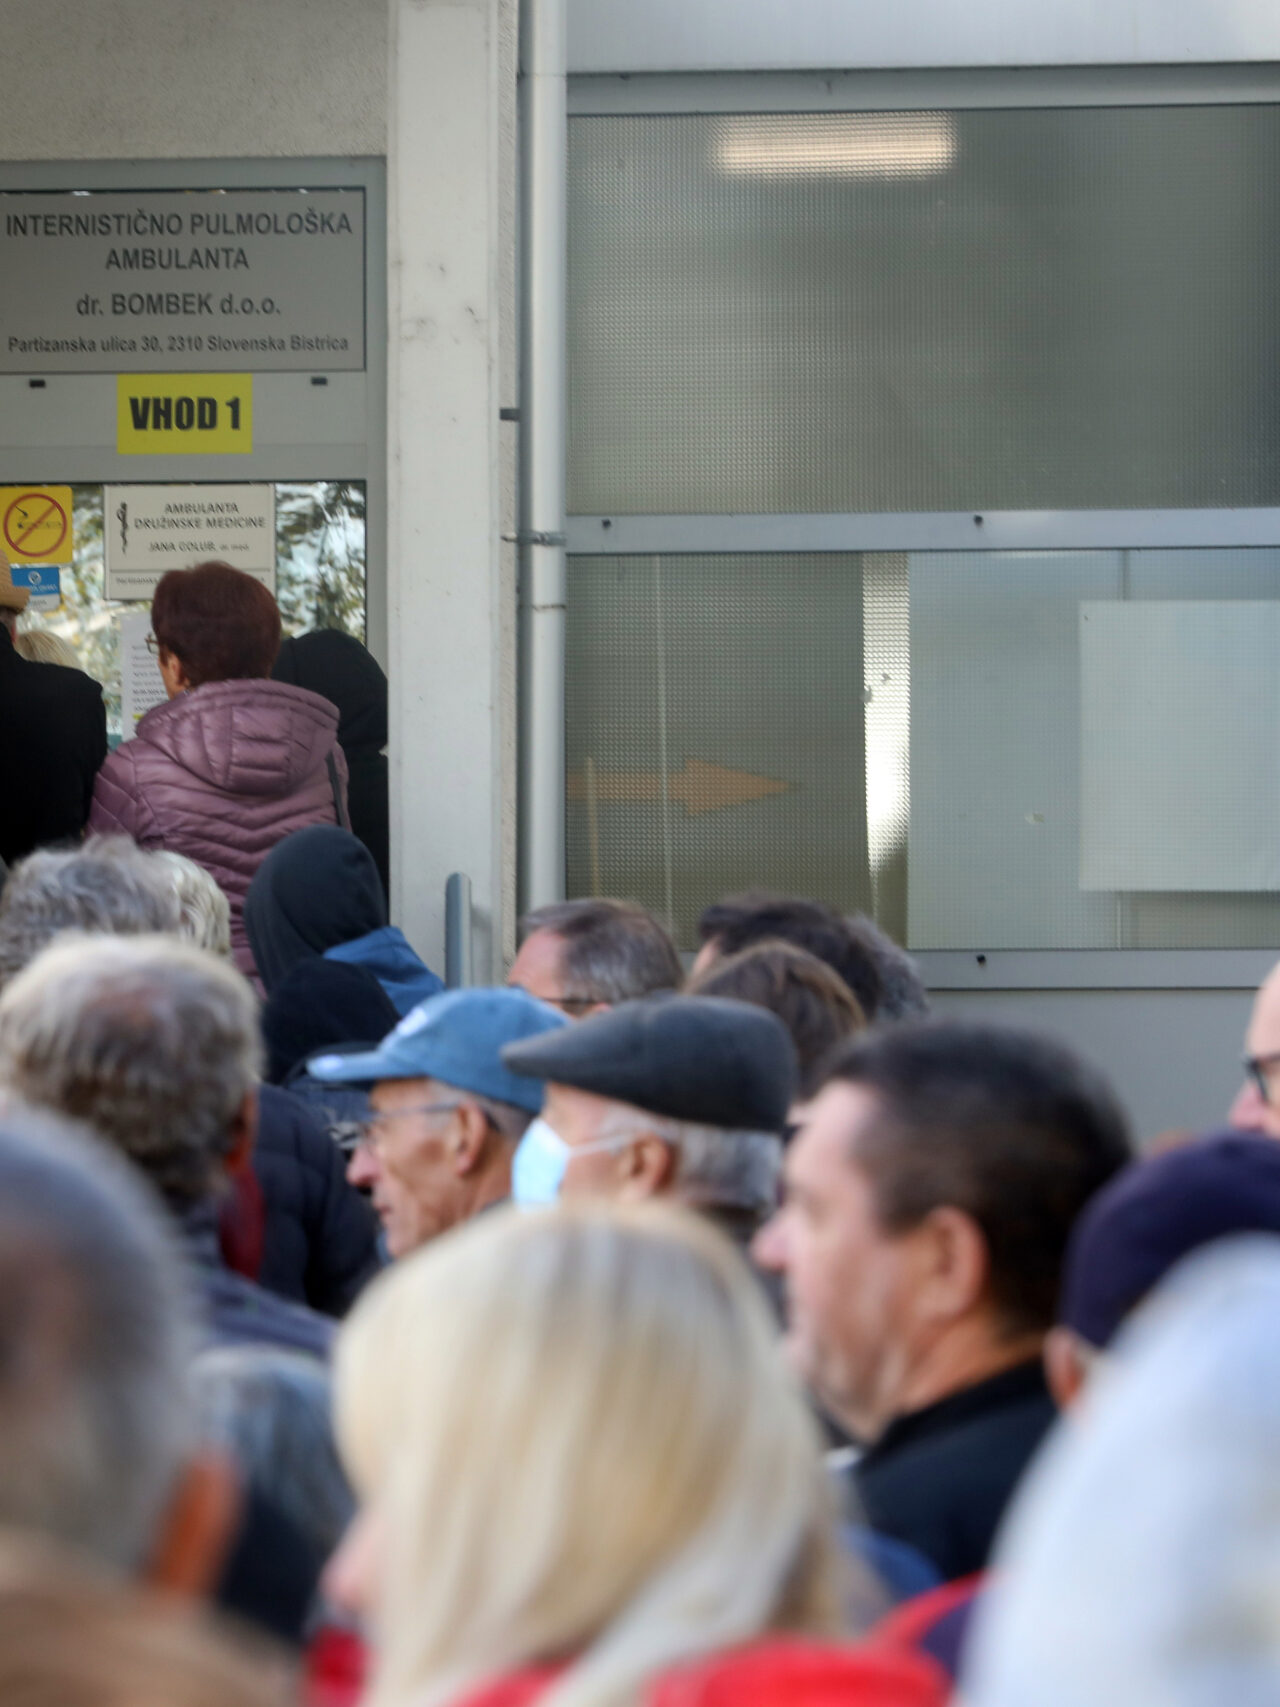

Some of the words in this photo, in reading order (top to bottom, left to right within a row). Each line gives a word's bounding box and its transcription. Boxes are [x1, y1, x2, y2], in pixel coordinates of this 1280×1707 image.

[6, 208, 183, 237] INTERNISTIČNO
[190, 207, 352, 236] PULMOLOŠKA
[105, 248, 250, 270] AMBULANTA
[76, 294, 104, 316] dr.
[112, 293, 213, 316] BOMBEK
[220, 293, 281, 315] d.o.o.
[8, 336, 96, 353] Partizanska
[100, 336, 137, 352] ulica
[167, 336, 202, 351] 2310
[207, 335, 286, 351] Slovenska
[290, 335, 349, 351] Bistrica
[129, 396, 218, 431] VHOD
[225, 396, 241, 431] 1
[165, 502, 239, 514] AMBULANTA
[206, 516, 265, 529] MEDICINE
